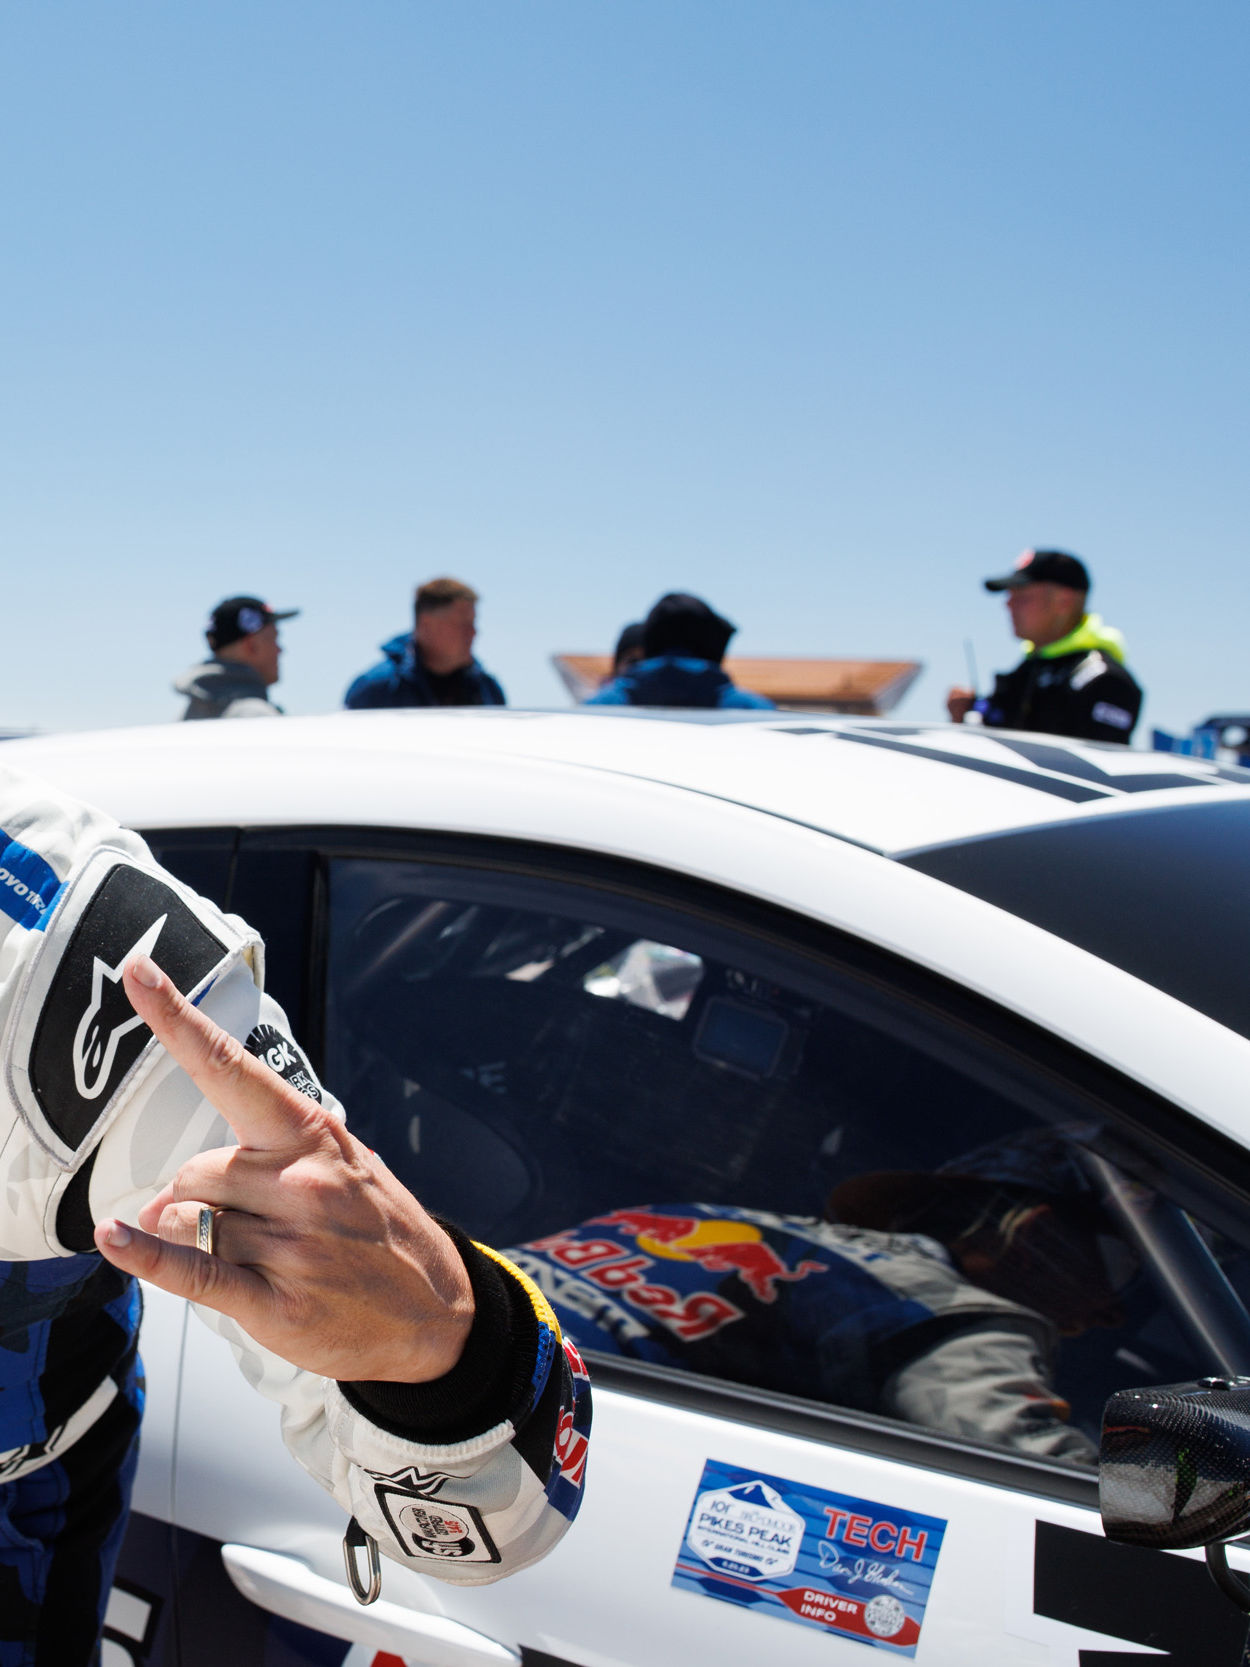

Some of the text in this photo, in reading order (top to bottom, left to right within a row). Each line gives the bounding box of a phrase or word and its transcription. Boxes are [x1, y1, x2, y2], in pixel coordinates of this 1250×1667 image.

[25, 890, 48, 916] TIR
[748, 1526, 792, 1547] PEAK
[823, 1506, 928, 1562] TECH
[800, 1603, 837, 1622] INFO
[803, 1590, 859, 1615] DRIVER
